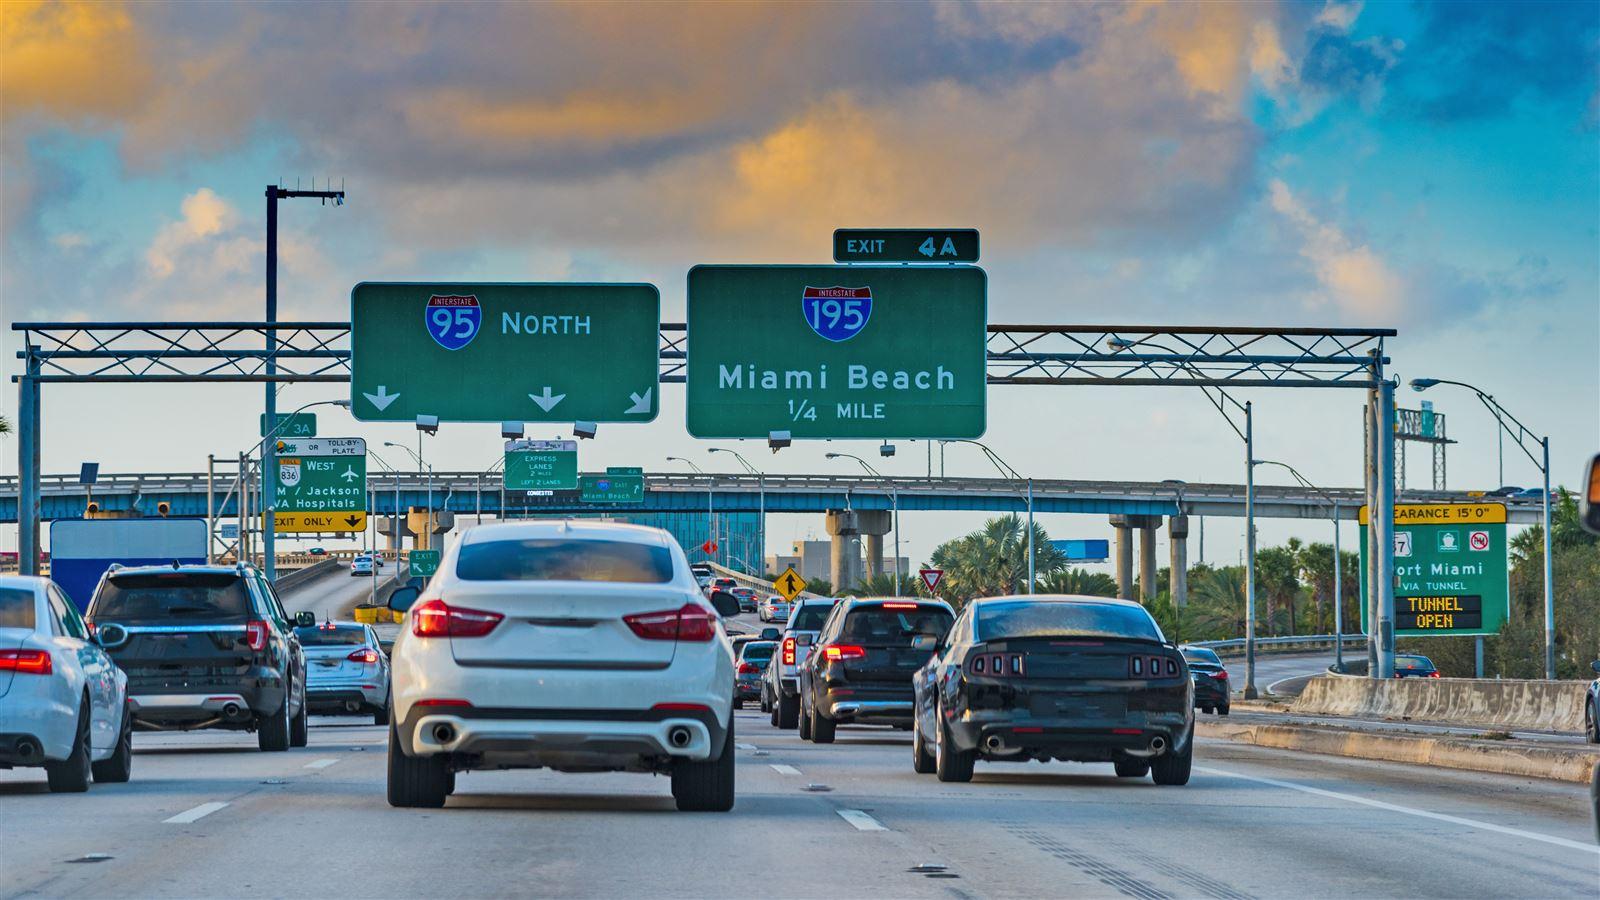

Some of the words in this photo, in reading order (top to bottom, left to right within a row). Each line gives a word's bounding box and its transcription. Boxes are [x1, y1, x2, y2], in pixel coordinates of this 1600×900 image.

[847, 239, 885, 253] EXIT
[818, 289, 856, 297] INTERSTATE
[434, 298, 472, 306] INTERSTATE
[811, 299, 864, 330] 195
[432, 308, 475, 339] 95
[501, 312, 591, 335] NORTH
[718, 364, 828, 390] Miami
[847, 364, 956, 390] Beach
[836, 403, 886, 419] MILE
[294, 424, 310, 434] 3A
[307, 461, 335, 471] WEST
[281, 471, 296, 480] 836
[306, 487, 360, 496] Jackson
[274, 499, 289, 508] VA
[296, 499, 355, 510] Hospitals
[274, 517, 296, 526] EXIT
[304, 517, 333, 526] ONLY
[1396, 563, 1421, 576] ort
[1431, 562, 1482, 575] Miami
[1402, 582, 1420, 591] VIA
[1426, 582, 1467, 590] TUNNEL
[1407, 597, 1463, 612] TUNNEL
[1416, 614, 1453, 628] OPEN
